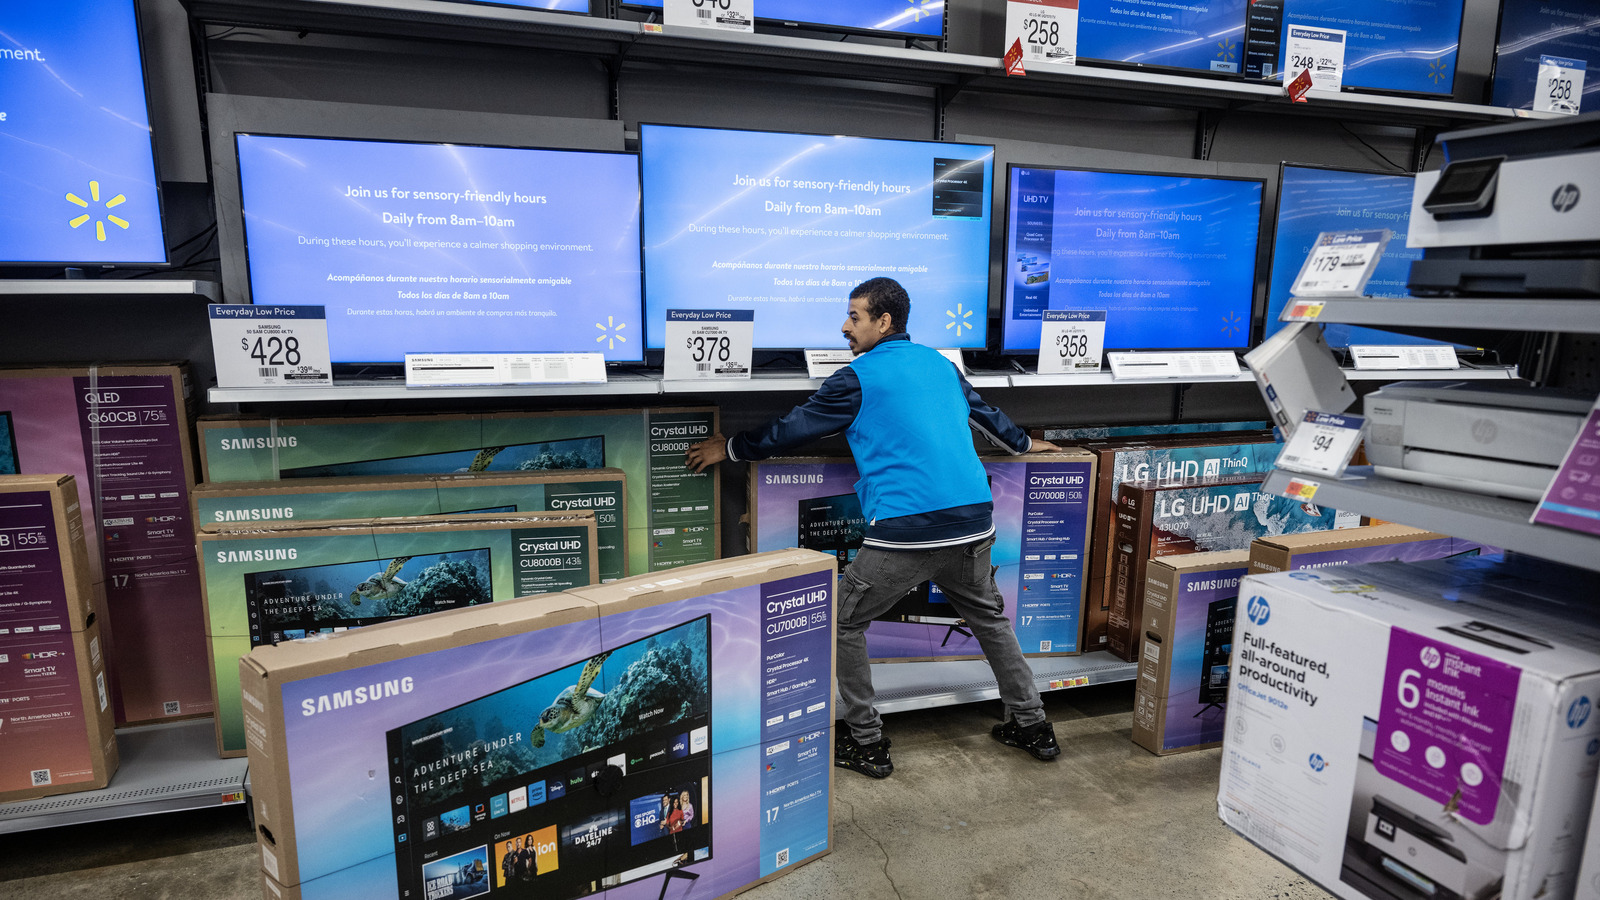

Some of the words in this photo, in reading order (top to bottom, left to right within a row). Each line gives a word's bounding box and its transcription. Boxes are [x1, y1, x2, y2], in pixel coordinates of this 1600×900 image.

[1024, 18, 1059, 46] $258
[1291, 55, 1314, 69] $248
[1548, 78, 1572, 100] $258
[733, 174, 756, 186] Join
[758, 178, 771, 187] us
[774, 176, 791, 188] for
[793, 179, 880, 195] sensory-friendly
[882, 182, 911, 194] hours
[344, 185, 371, 198] Join
[374, 190, 388, 198] us
[390, 186, 410, 199] for
[412, 190, 512, 206] sensory-friendly
[514, 191, 547, 204] hours
[1023, 195, 1037, 203] UHD
[1038, 195, 1049, 204] TV
[765, 200, 793, 216] Daily
[794, 201, 822, 214] from
[1074, 208, 1090, 217] Join
[1103, 209, 1116, 218] for
[1117, 210, 1179, 222] sensory-friendly
[1181, 212, 1202, 221] hours
[382, 212, 414, 228] Daily
[416, 213, 447, 225] from
[298, 235, 330, 248] During
[331, 236, 357, 246] these
[358, 237, 386, 248] hours,
[388, 238, 412, 249] you'll
[413, 239, 462, 250] experience
[469, 240, 499, 249] calmer
[500, 241, 538, 252] shopping
[540, 242, 594, 252] environment.
[1313, 256, 1340, 272] $179
[326, 273, 384, 284] Acompáñanos
[386, 274, 418, 282] durante
[450, 275, 478, 284] horario
[480, 276, 536, 284] sensorialmente
[537, 276, 572, 287] amigable
[397, 290, 420, 299] Todos
[421, 291, 432, 299] los
[434, 291, 450, 299] días
[451, 291, 462, 300] de
[462, 291, 480, 300] 8am
[489, 292, 510, 300] 10am
[216, 308, 254, 317] Everyday
[671, 311, 700, 320] Everyday
[241, 336, 301, 366] $428
[686, 336, 730, 362] $378
[1056, 335, 1088, 358] $358
[84, 392, 120, 404] QLED
[88, 411, 137, 423] Q60CB
[651, 426, 687, 438] Crystal
[688, 425, 708, 434] UHD
[221, 436, 297, 450] SAMSUNG
[651, 442, 689, 452] CU8000B
[1312, 435, 1334, 452] $94
[1122, 463, 1149, 483] LG
[1156, 460, 1199, 481] UHD
[1222, 457, 1248, 468] ThinQ
[765, 474, 824, 484] SAMSUNG
[1030, 476, 1064, 487] Crystal
[1065, 476, 1084, 484] UHD
[1029, 492, 1065, 500] CU7000B
[551, 498, 592, 511] Crystal
[593, 497, 616, 506] UHD
[1159, 498, 1185, 518] LG
[1191, 495, 1230, 514] UHD
[214, 507, 294, 522] SAMSUNG
[1159, 522, 1189, 532] 43UQ70
[519, 542, 558, 553] Crystal
[560, 541, 581, 550] UHD
[217, 548, 297, 563] SAMSUNG
[520, 558, 562, 568] CU8000B
[112, 574, 129, 587] 17
[1148, 577, 1169, 590] SAMSUNG
[1187, 578, 1237, 592] SAMSUNG
[263, 594, 312, 605] ADVENTURE
[315, 592, 343, 601] UNDER
[767, 594, 805, 614] Crystal
[807, 590, 827, 604] UHD
[1247, 595, 1270, 626] hp
[767, 615, 807, 635] CU7000B
[1021, 616, 1033, 626] 17
[766, 652, 785, 661] PurColor
[1243, 632, 1330, 679] Full-featured,
[1420, 646, 1441, 669] hp
[1241, 649, 1305, 684] all-around
[1239, 664, 1318, 707] productivity
[1397, 668, 1421, 709] 6
[1427, 678, 1466, 700] months
[302, 676, 414, 716] SAMSUNG
[1425, 688, 1460, 711] Instant
[1462, 703, 1479, 718] Ink
[638, 710, 653, 720] Watch
[653, 707, 664, 716] Now
[413, 746, 479, 778] ADVENTURE
[483, 732, 522, 754] UNDER
[414, 779, 435, 795] THE
[439, 770, 468, 787] DEEP
[473, 760, 494, 776] SEA
[570, 776, 583, 785] hulu
[766, 806, 779, 823] 17
[575, 827, 612, 845] DATELINE
[586, 837, 601, 848] 24/7
